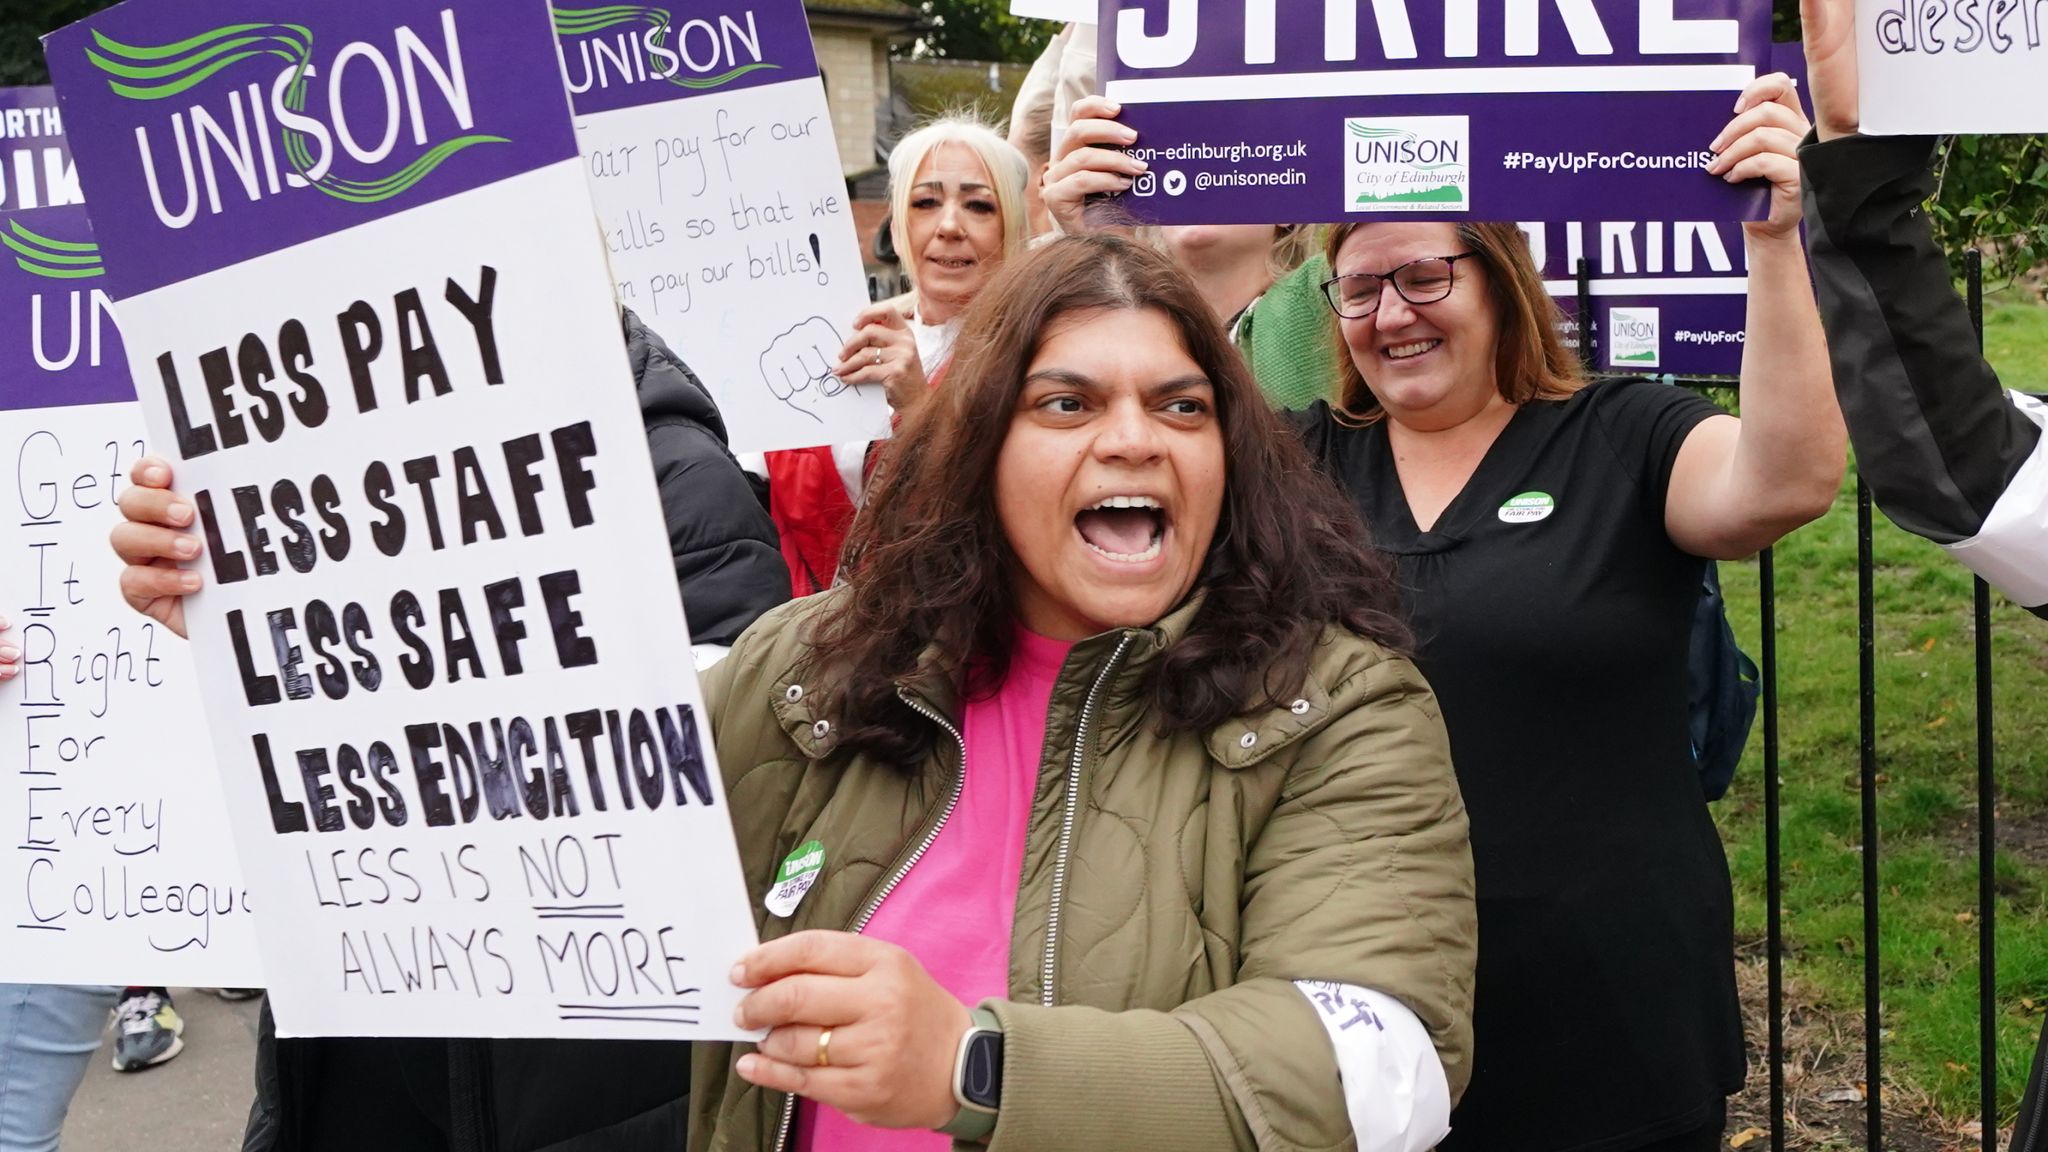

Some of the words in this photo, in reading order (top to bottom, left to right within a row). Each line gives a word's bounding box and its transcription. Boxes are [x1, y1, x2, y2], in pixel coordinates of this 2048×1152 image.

[558, 10, 763, 94] UNISON
[0, 106, 63, 139] RTH
[134, 8, 474, 229] UNISON
[1116, 140, 1307, 163] ison-edinburgh.org.uk
[1355, 140, 1458, 164] UNISON
[578, 128, 638, 178] air
[654, 134, 707, 205] pay
[712, 109, 756, 182] for
[770, 116, 818, 141] our
[1194, 168, 1306, 191] @unisonedin
[1357, 172, 1381, 186] City
[1385, 171, 1399, 185] of
[1401, 171, 1465, 186] Edinburgh
[1503, 151, 1719, 173] #PayUpForCouncilS
[685, 218, 716, 239] so
[730, 191, 794, 231] that
[809, 196, 840, 218] we
[649, 271, 691, 315] pay
[701, 262, 734, 283] our
[156, 318, 329, 461] LESS
[336, 265, 505, 413] PAY
[1613, 322, 1655, 337] UNISON
[194, 473, 351, 585] LESS
[362, 420, 598, 557] STAFF
[23, 543, 85, 611] It
[24, 623, 163, 718] Right
[226, 599, 382, 707] LESS
[389, 569, 599, 690] SAFE
[27, 714, 106, 772] For
[252, 732, 408, 835] LESS
[404, 704, 715, 828] EDUCATION
[28, 787, 163, 856] Every
[306, 846, 422, 907] LESS
[441, 845, 490, 902] IS
[518, 834, 623, 899] NOT
[341, 927, 515, 998] ALWAYS
[536, 925, 701, 997] MORE
